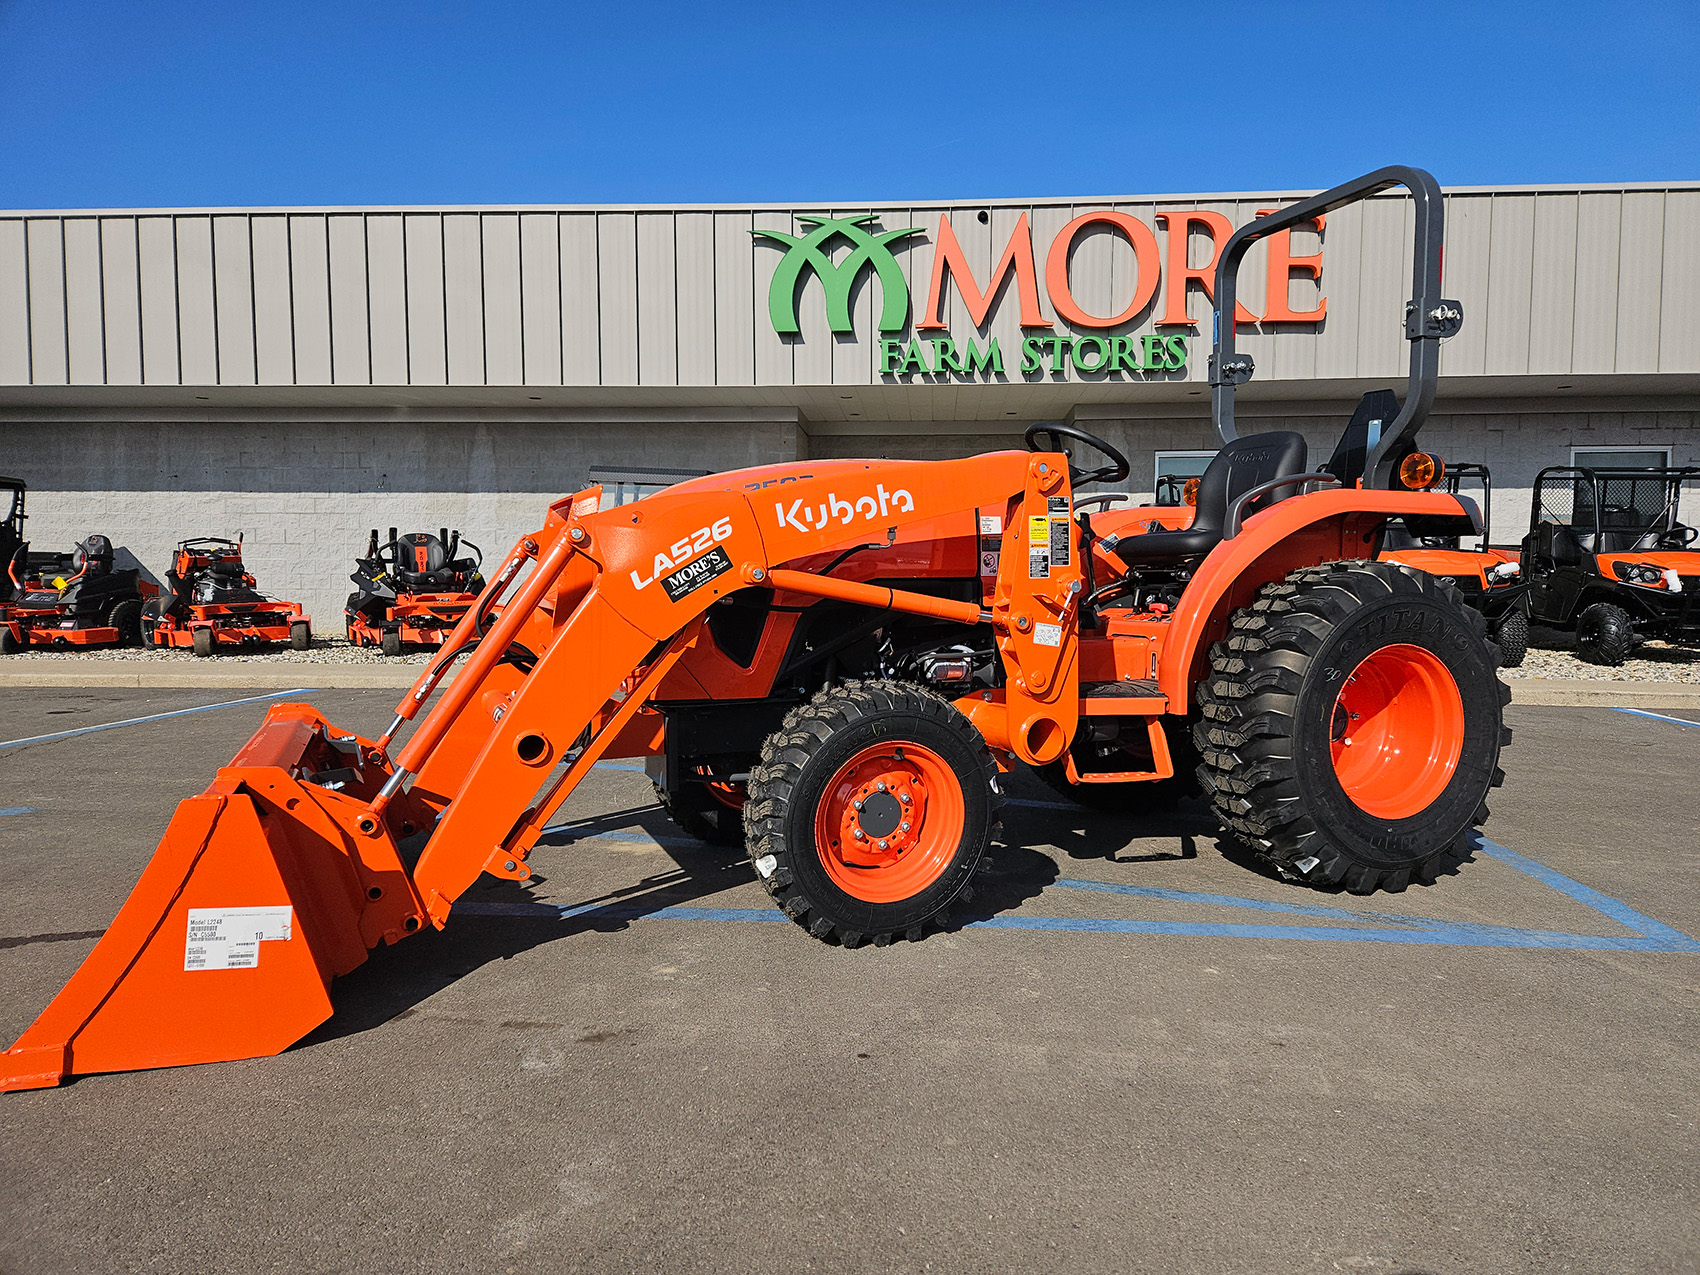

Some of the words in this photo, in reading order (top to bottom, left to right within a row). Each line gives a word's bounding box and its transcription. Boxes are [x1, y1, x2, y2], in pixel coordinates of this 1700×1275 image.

[916, 208, 1327, 329] MORE
[878, 337, 1005, 373] FARM
[1020, 334, 1187, 372] STORES
[775, 483, 915, 533] Kubota
[630, 515, 732, 591] LA526
[667, 551, 721, 590] MORE'S
[1358, 608, 1456, 647] TITAN
[255, 931, 264, 940] 10
